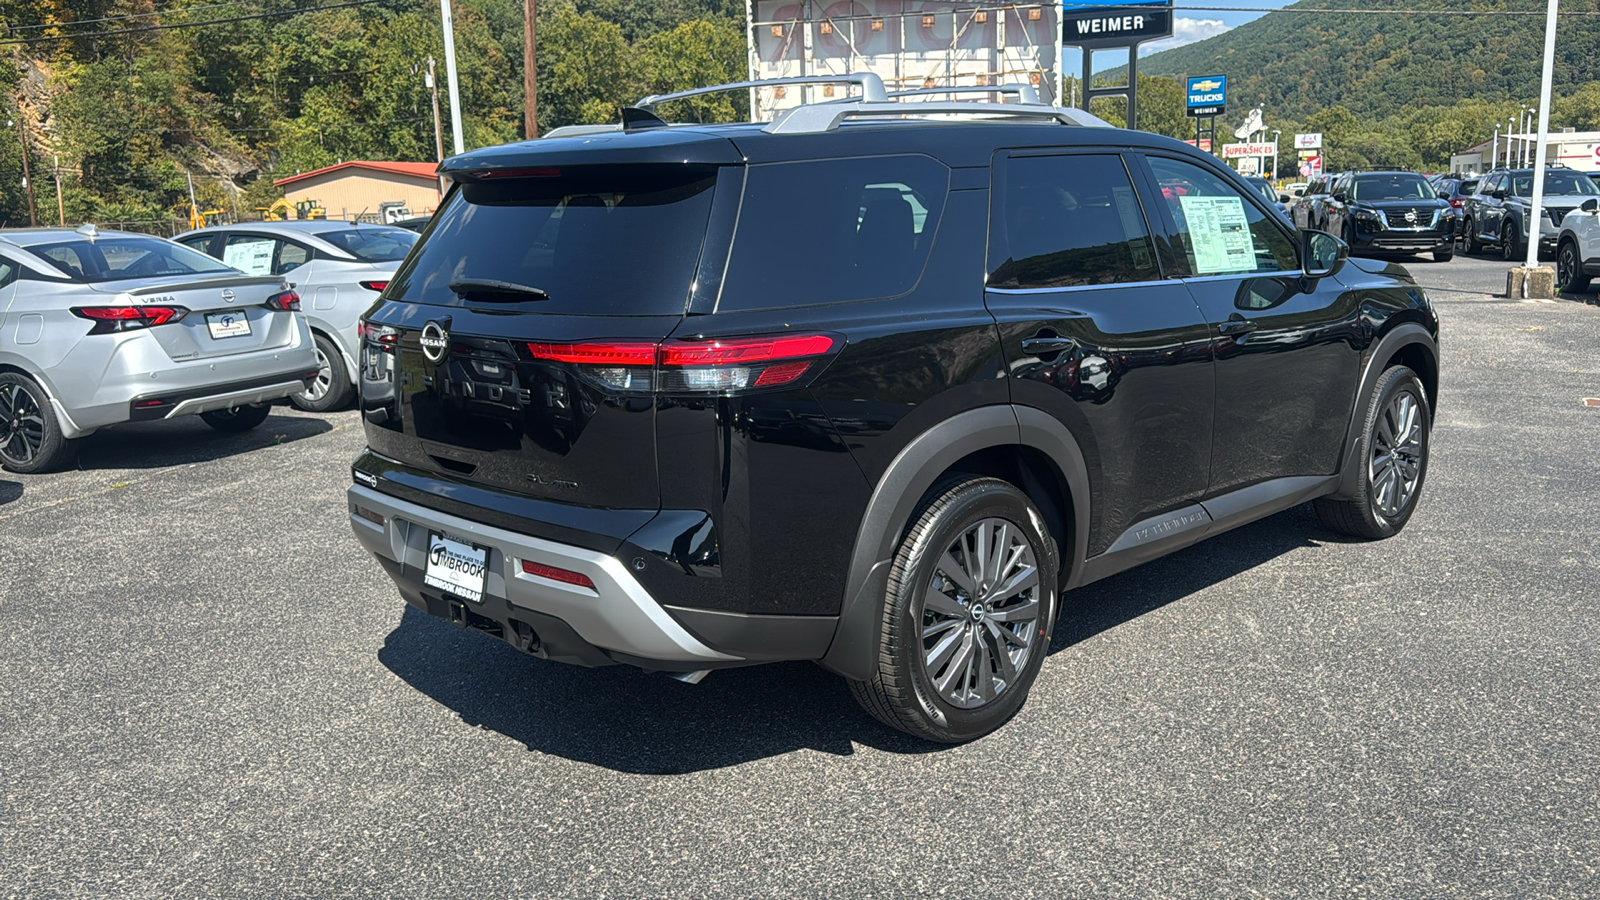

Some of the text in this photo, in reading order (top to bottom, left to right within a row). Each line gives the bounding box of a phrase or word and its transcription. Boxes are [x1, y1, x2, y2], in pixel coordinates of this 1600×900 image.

[1076, 15, 1144, 34] WEIMER
[1189, 93, 1223, 103] TRUCKS
[1224, 146, 1247, 155] SUPER
[419, 337, 447, 348] NISSAN
[462, 555, 474, 563] PLACE
[424, 574, 482, 603] TIMBROOK NISSAN
